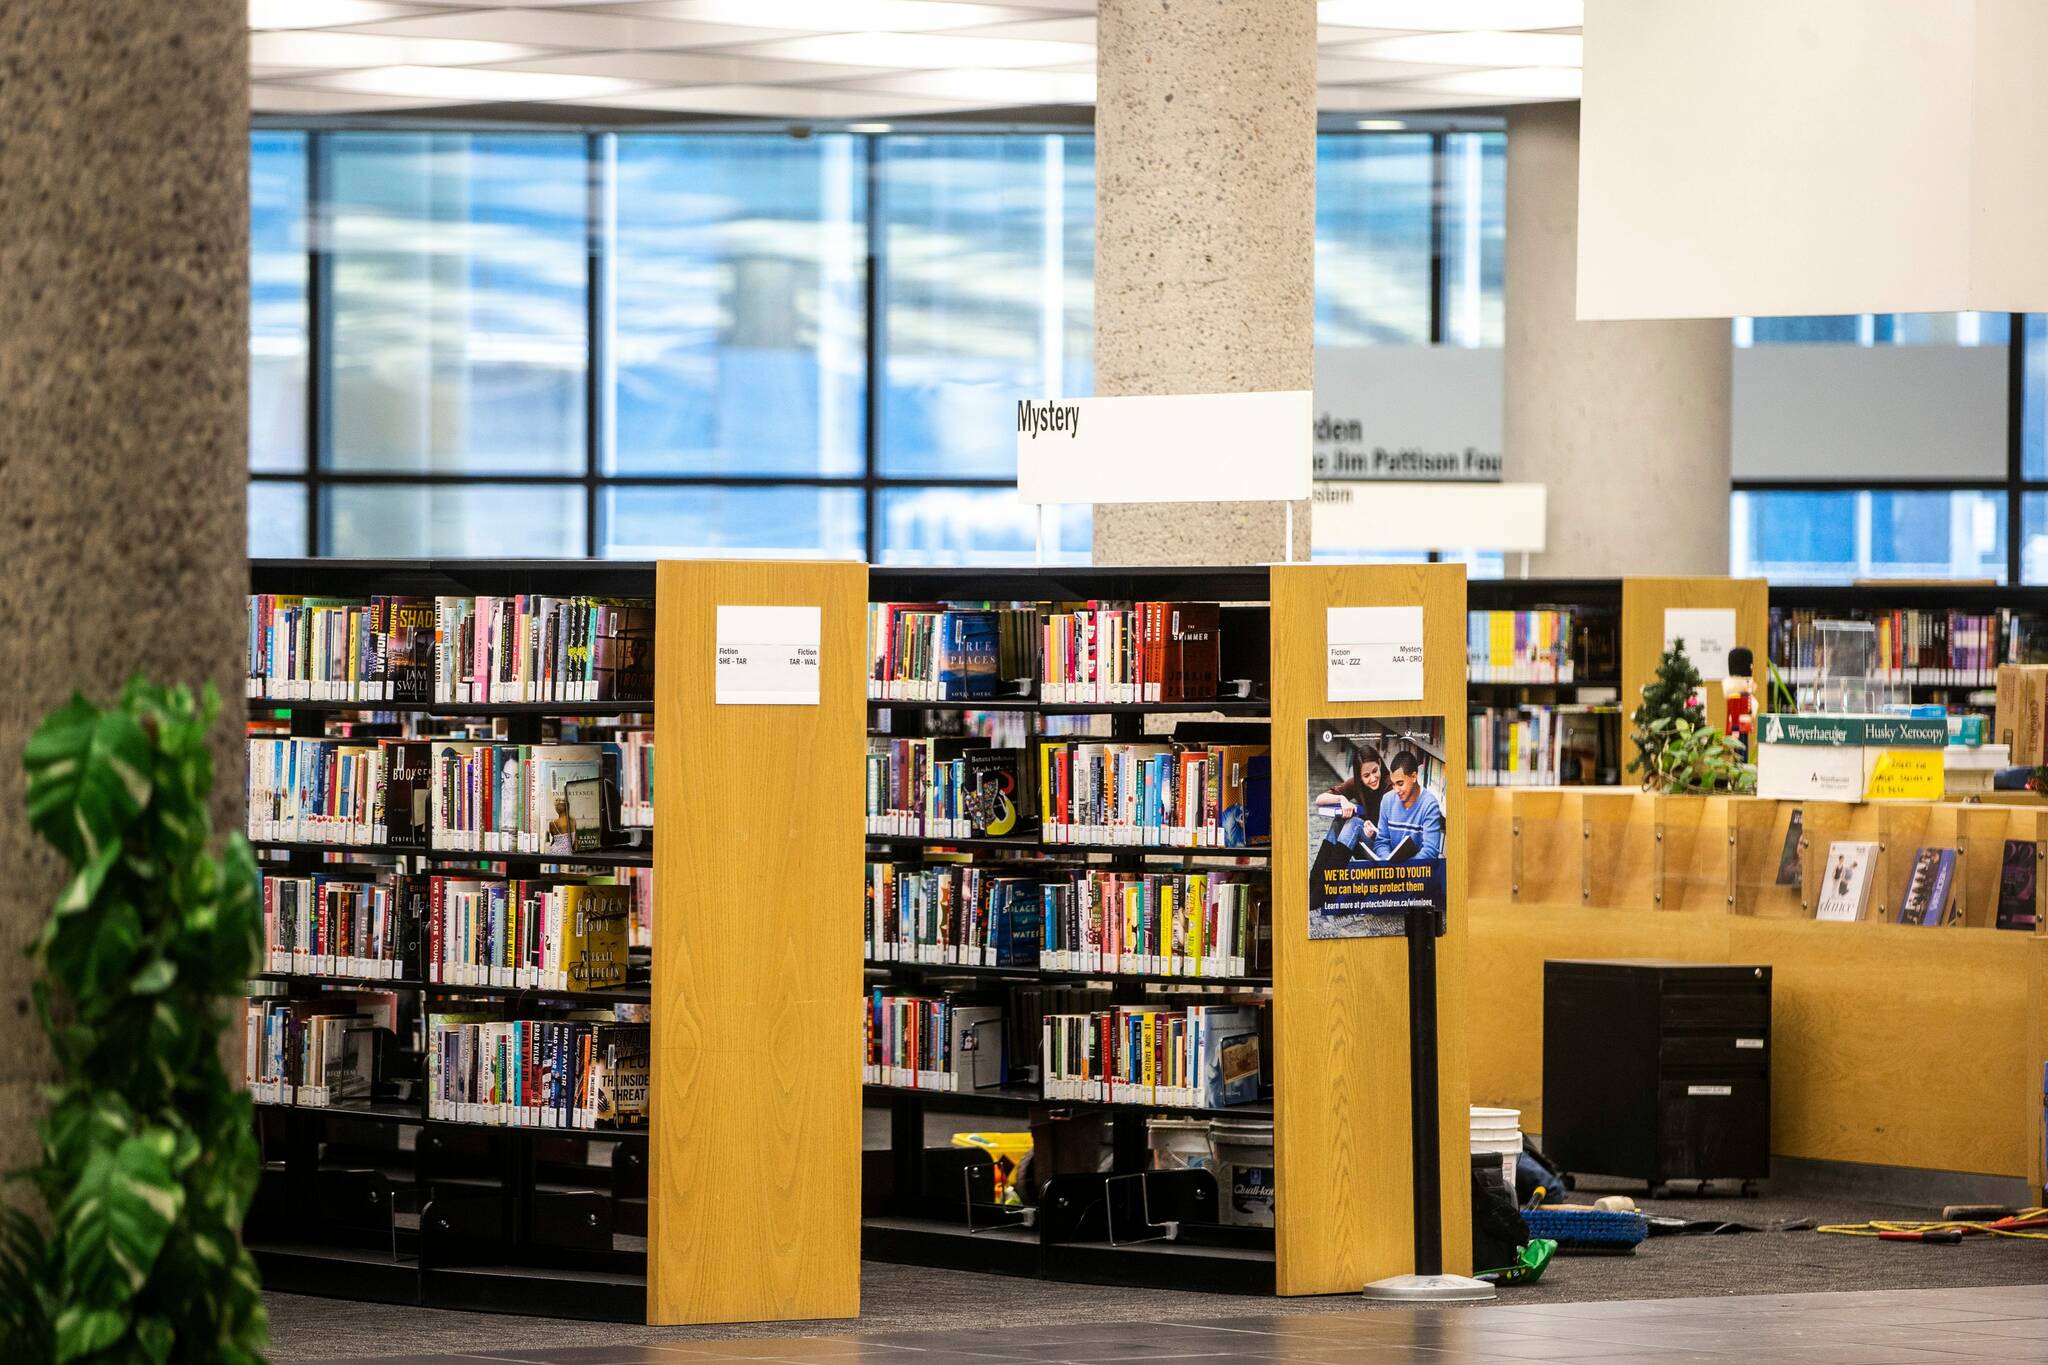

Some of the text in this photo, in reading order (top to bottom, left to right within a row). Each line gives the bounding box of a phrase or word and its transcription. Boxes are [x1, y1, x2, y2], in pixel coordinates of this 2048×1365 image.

[1017, 400, 1079, 438] Mystery
[1334, 450, 1366, 470] Jim
[1373, 449, 1459, 471] Pattison
[371, 605, 379, 635] GHOST
[376, 633, 386, 672] NOMAD
[958, 641, 991, 651] TRUE
[950, 656, 996, 665] PLACES
[1349, 658, 1361, 666] ZZZ
[1865, 724, 1944, 744] Husky Xerocopy
[1324, 866, 1431, 881] WE'RE COMMITTED TO YOUTH
[434, 881, 439, 894] WE
[1324, 881, 1425, 896] You can help us protect them
[577, 898, 622, 912] GOLDEN
[1324, 902, 1339, 910] Learn
[589, 919, 609, 931] BOY
[602, 1075, 618, 1087] THE
[611, 1088, 645, 1101] THREAT
